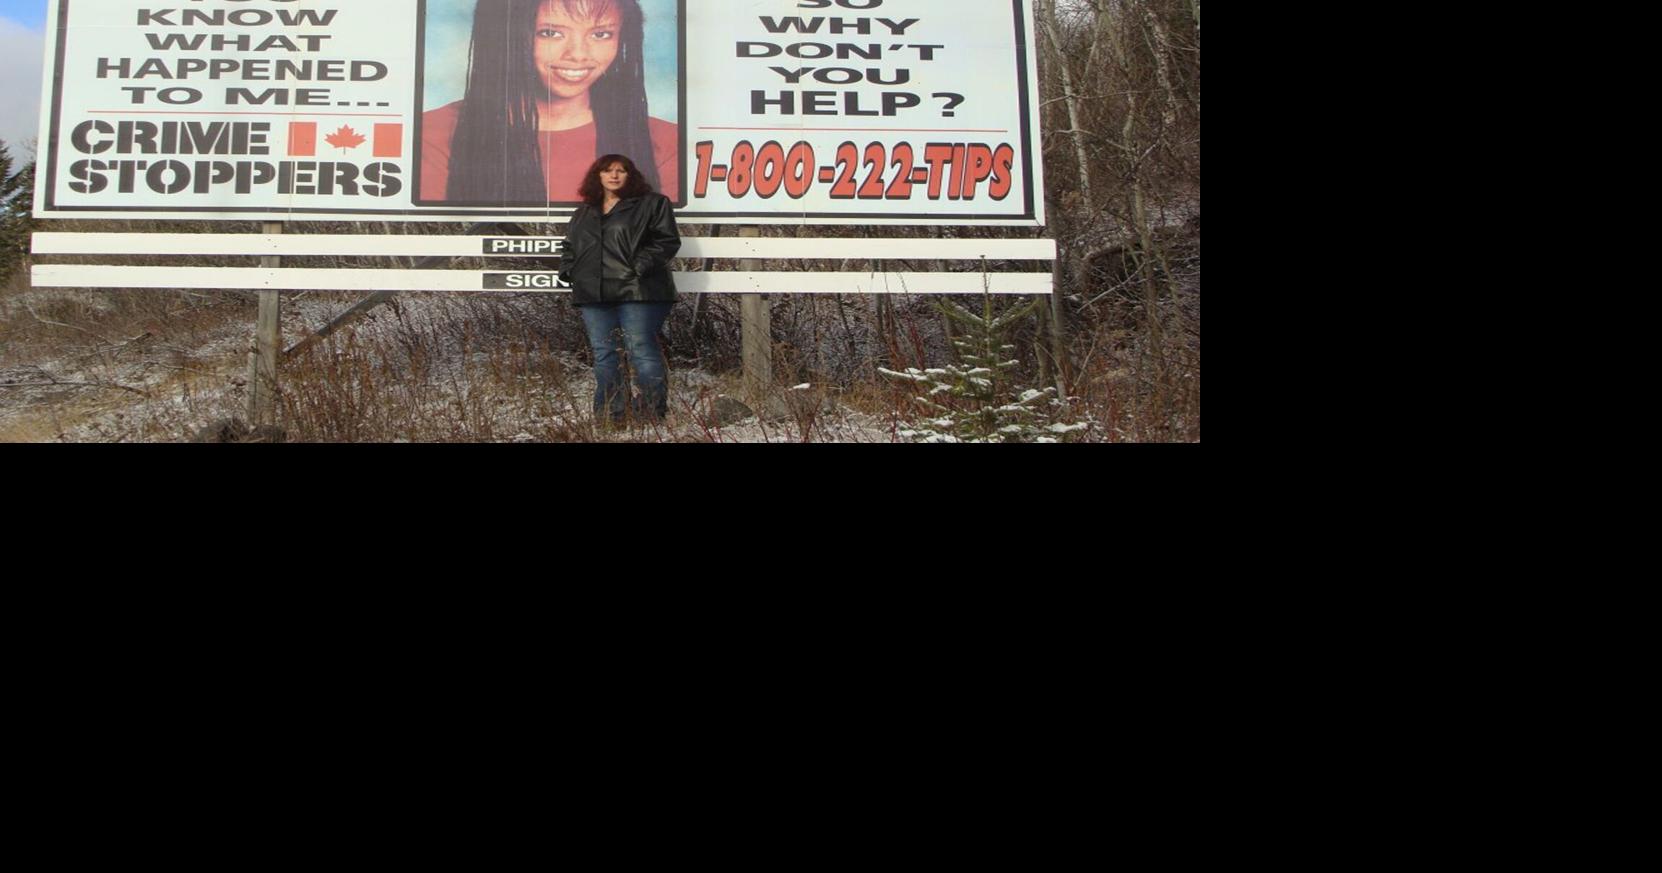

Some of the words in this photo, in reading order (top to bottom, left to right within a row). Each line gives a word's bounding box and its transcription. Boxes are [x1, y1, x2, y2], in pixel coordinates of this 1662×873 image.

[137, 9, 338, 26] KNOW
[759, 16, 920, 35] WHY
[145, 33, 331, 51] WHAT
[736, 42, 944, 61] DON'T
[97, 58, 387, 81] HAPPENED
[768, 67, 910, 85] YOU
[121, 87, 202, 104] TO
[225, 88, 389, 106] ME...
[71, 120, 270, 155] CRIME
[68, 159, 402, 197] STOPPERS
[694, 140, 1014, 201] 1-800-222-TIPS
[505, 274, 573, 288] SIGN
